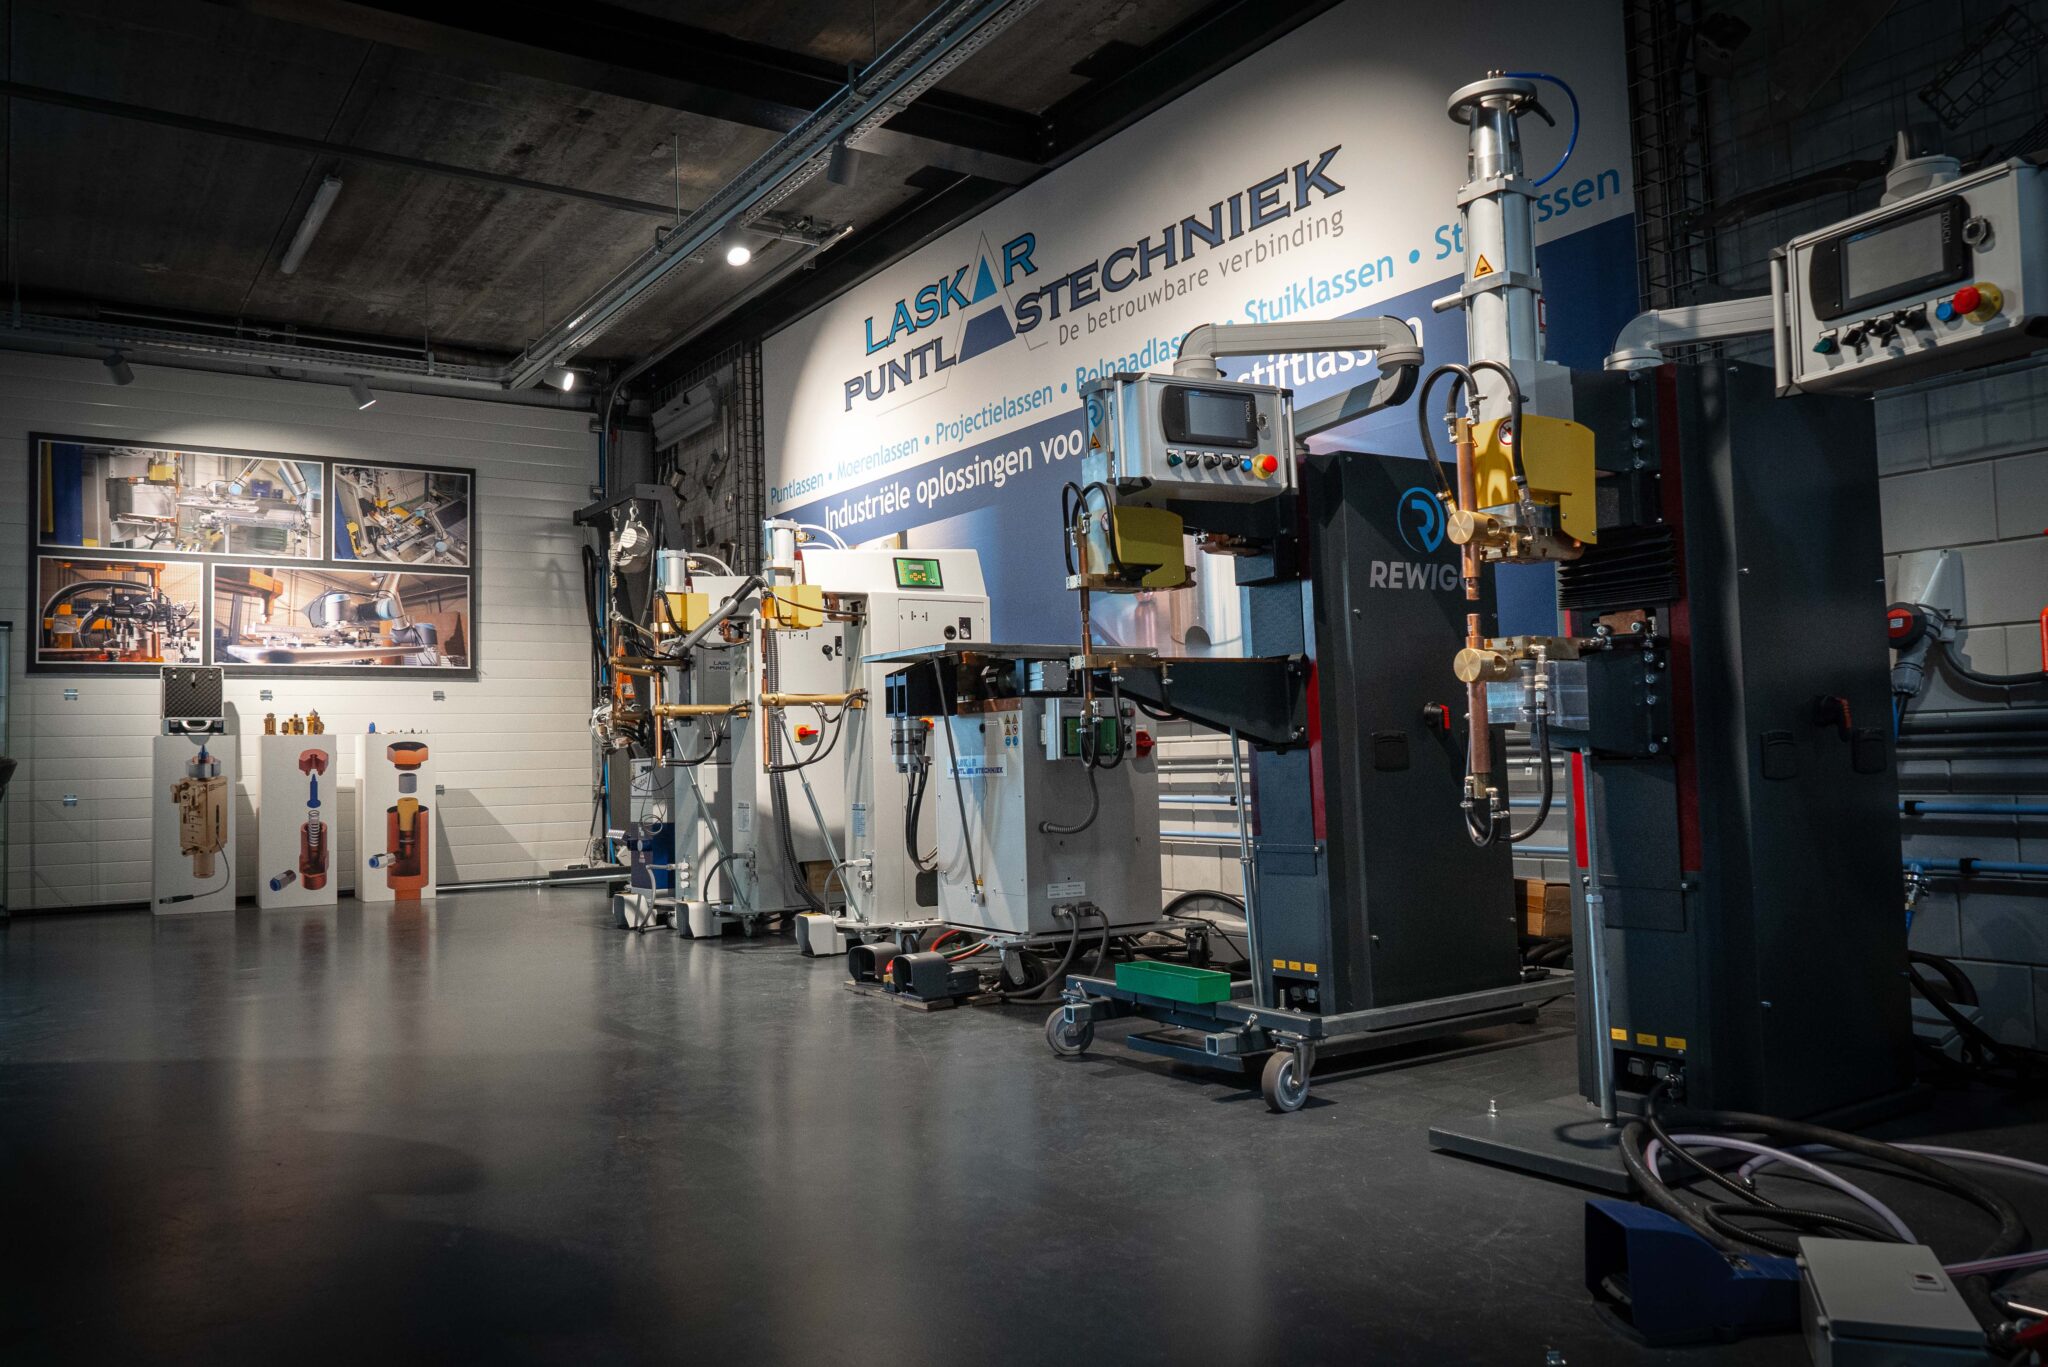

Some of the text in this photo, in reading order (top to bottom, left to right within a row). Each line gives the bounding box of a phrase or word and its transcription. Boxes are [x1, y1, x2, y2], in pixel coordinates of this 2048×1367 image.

[1058, 209, 1345, 346] De betrouwbare verbinding
[770, 470, 824, 505] Puntlassen
[837, 435, 919, 481] Moerenlassen
[936, 384, 1053, 445] Projectielassen
[1076, 332, 1189, 393] Rolnaadlas
[1244, 254, 1394, 325] Stuiklassen
[825, 482, 910, 531] Industriële
[916, 445, 1033, 509] oplossingen
[1040, 429, 1083, 464] voo
[1369, 560, 1464, 591] REWIG
